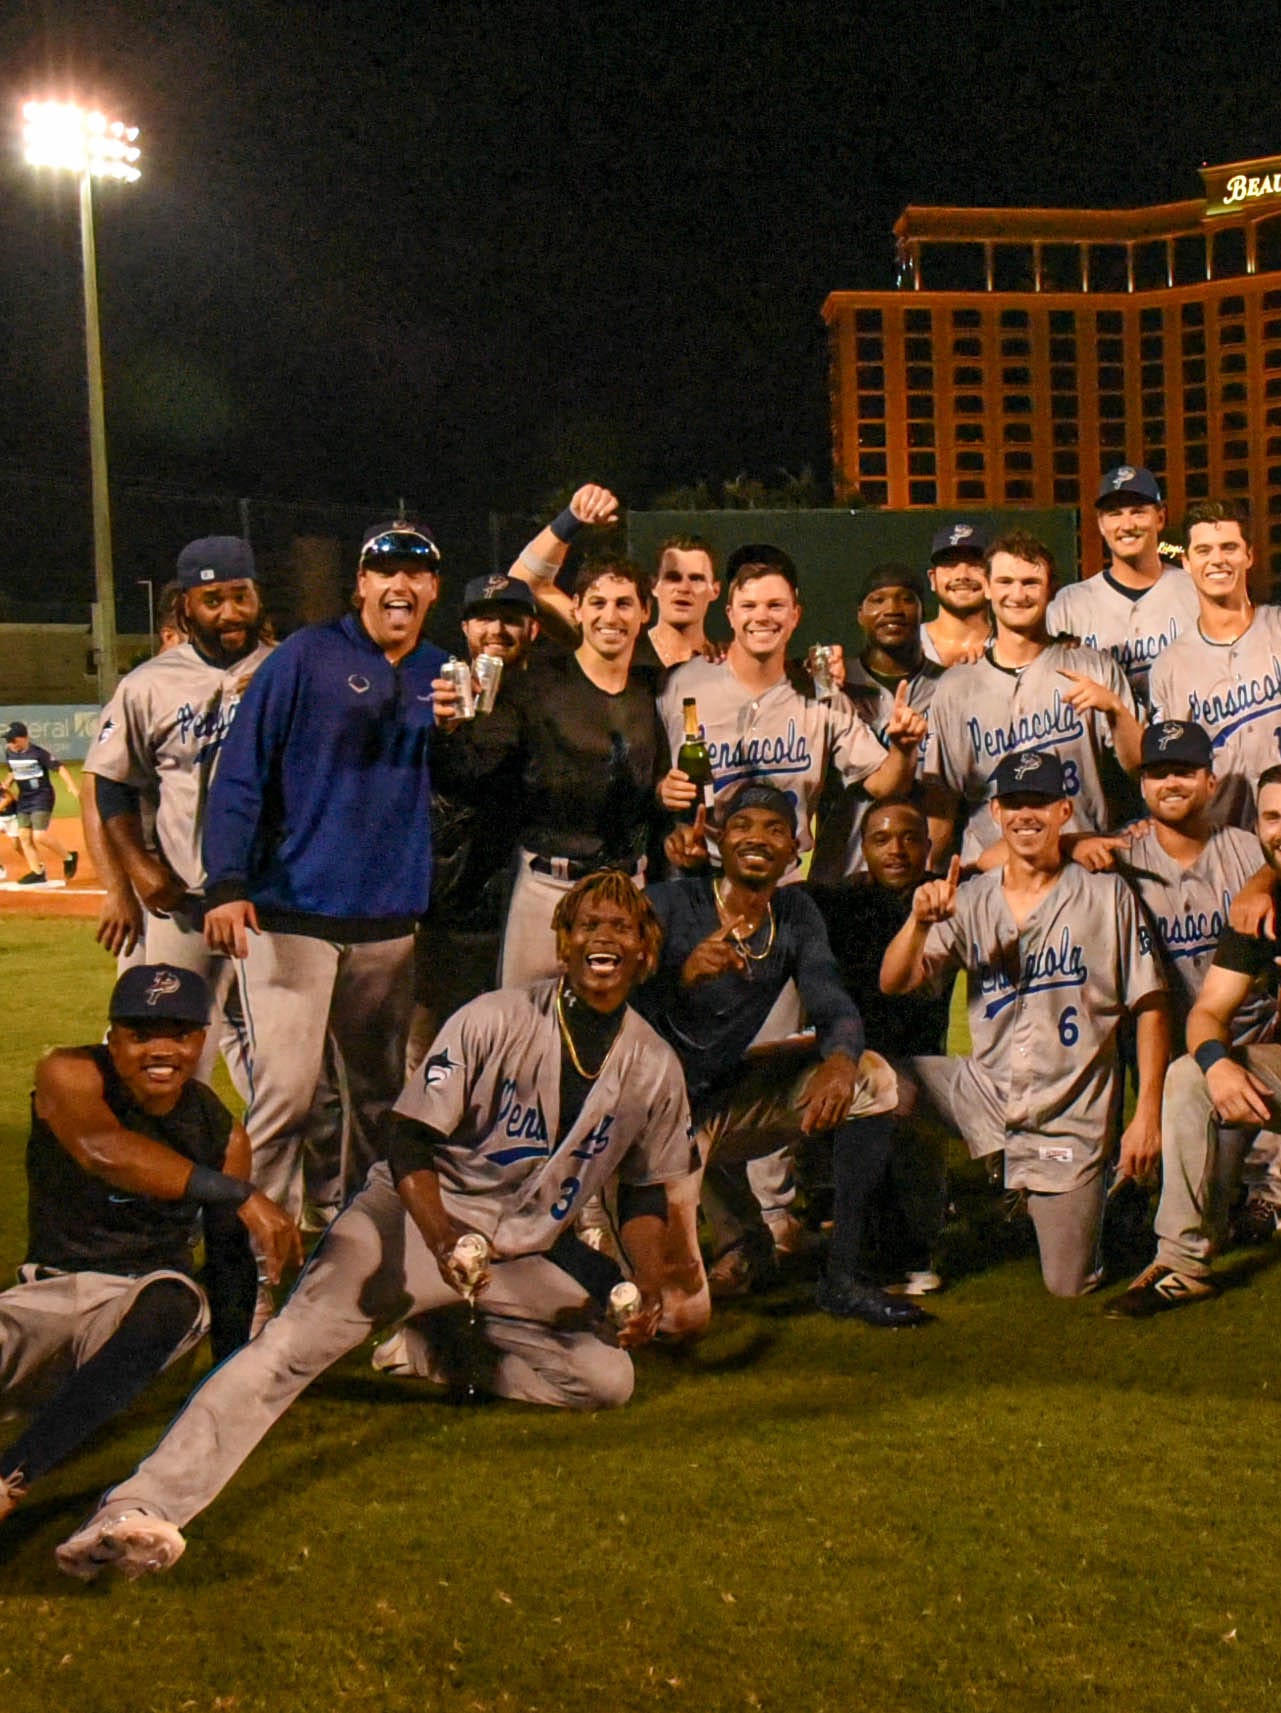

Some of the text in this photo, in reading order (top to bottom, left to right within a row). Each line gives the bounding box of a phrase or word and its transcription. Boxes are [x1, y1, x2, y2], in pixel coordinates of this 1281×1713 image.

[967, 689, 1084, 763] Pensacola
[1059, 1006, 1079, 1046] 6
[551, 1177, 580, 1220] 3
